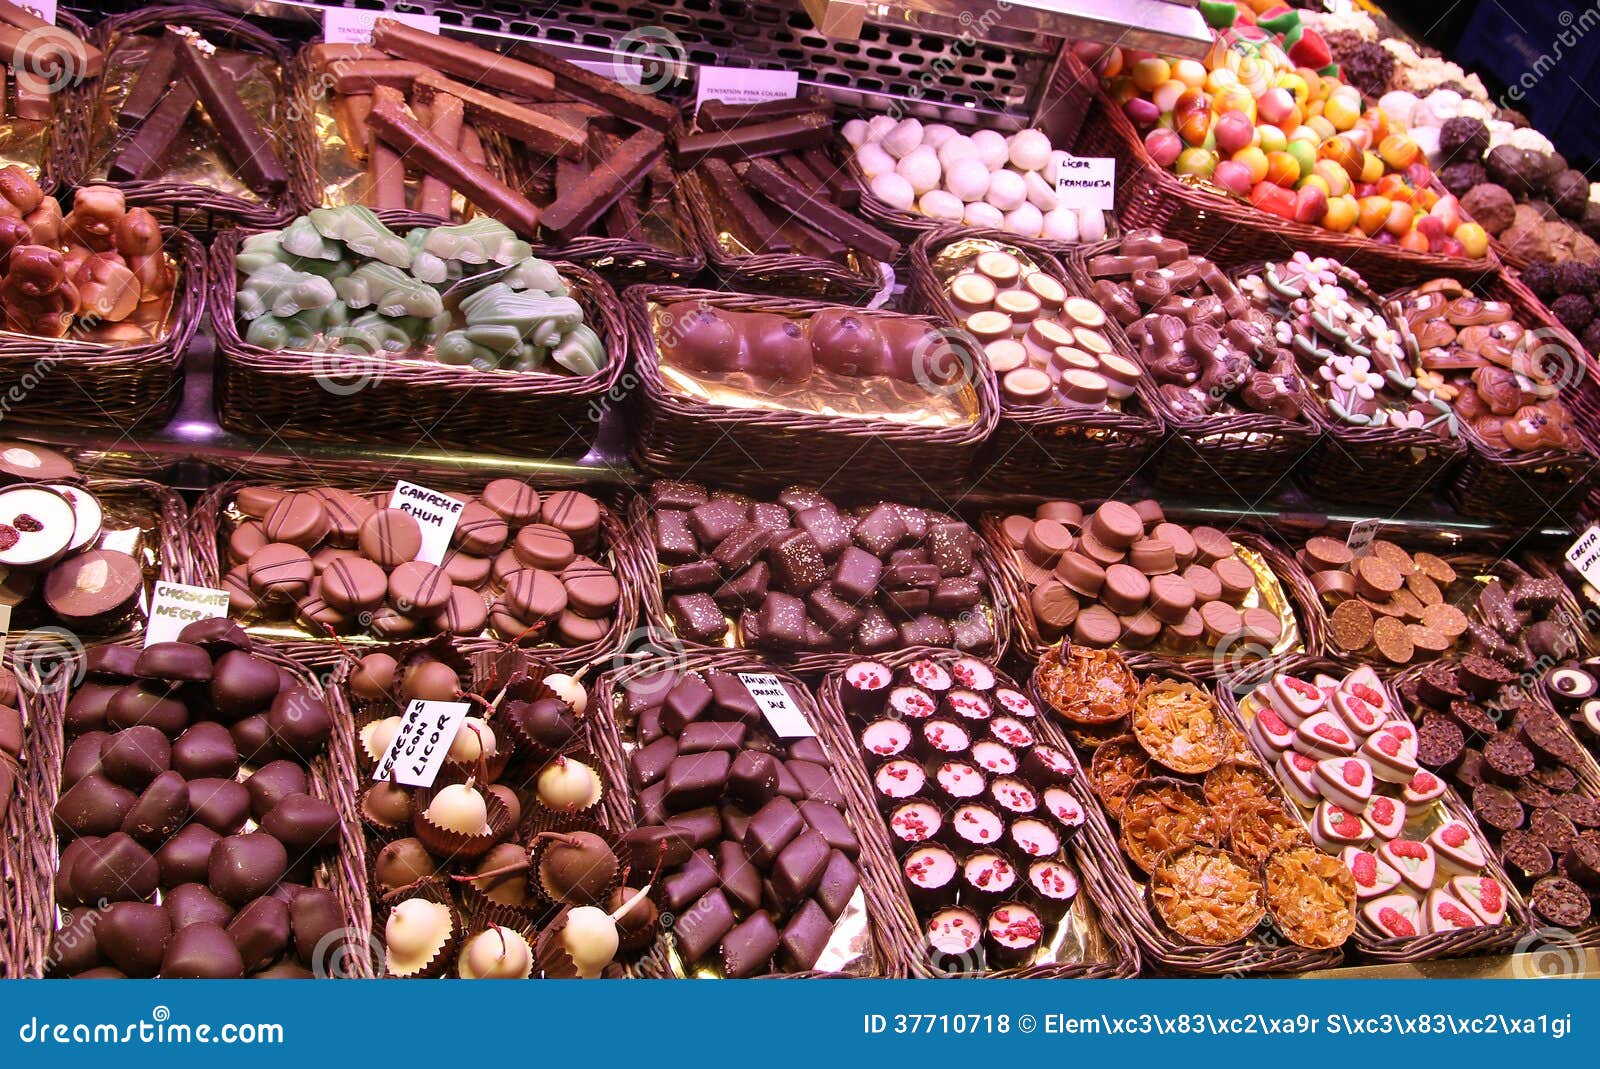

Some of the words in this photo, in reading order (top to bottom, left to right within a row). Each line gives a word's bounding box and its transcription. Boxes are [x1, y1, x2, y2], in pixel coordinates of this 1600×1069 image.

[399, 485, 463, 513] GANACHE
[400, 502, 443, 527] RHUM
[1570, 533, 1598, 561] CREMA
[1582, 547, 1600, 572] CATAL
[157, 586, 230, 607] CHOCOLATE
[752, 688, 785, 696] CARAMEL
[380, 701, 425, 779] CEREZAS
[405, 722, 428, 756] CON
[412, 714, 451, 776] LICOR
